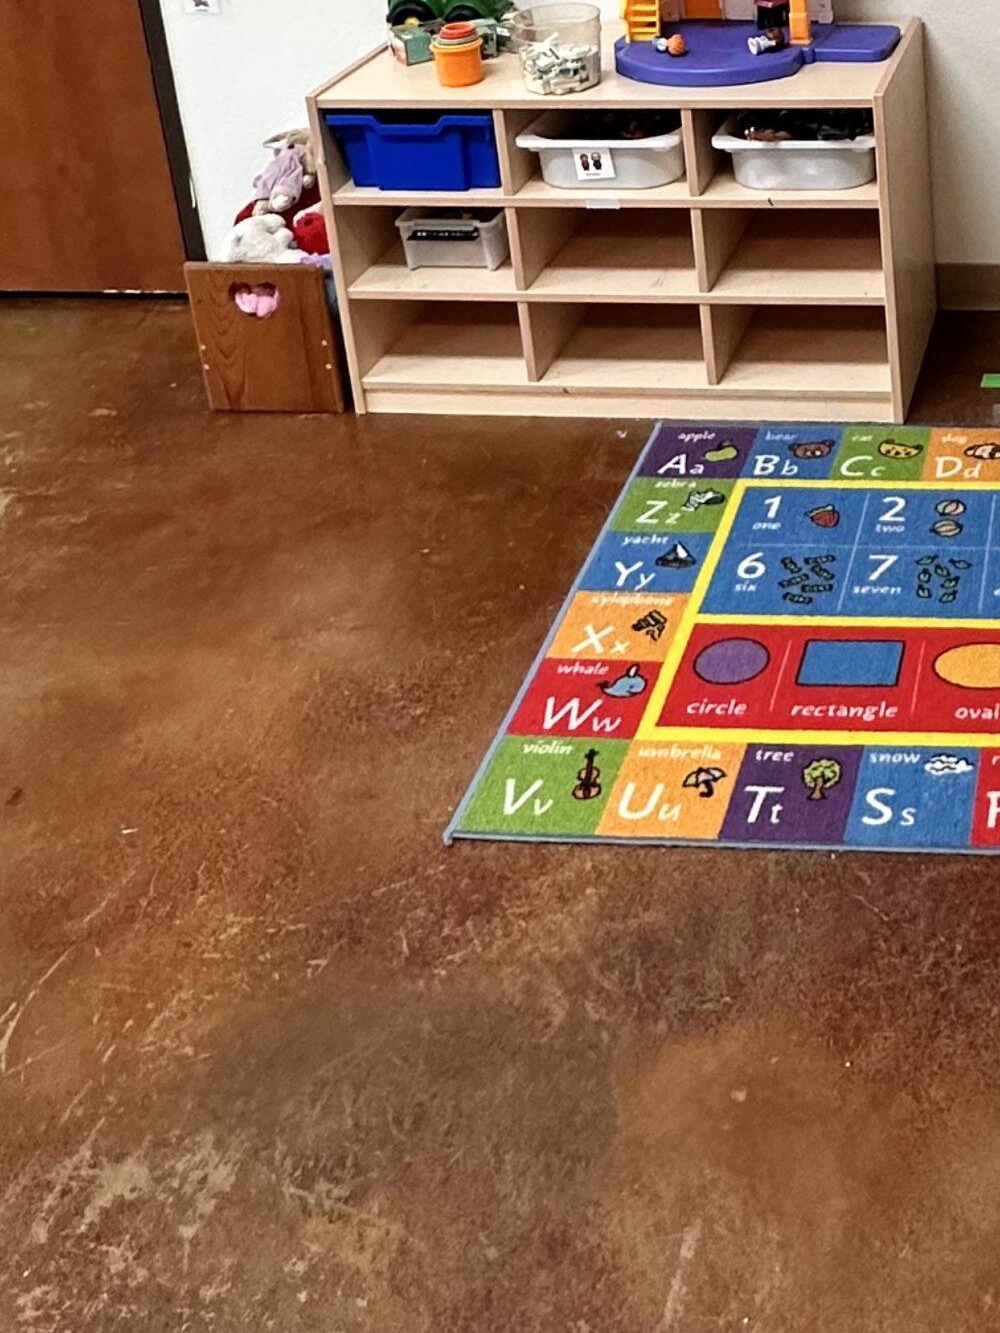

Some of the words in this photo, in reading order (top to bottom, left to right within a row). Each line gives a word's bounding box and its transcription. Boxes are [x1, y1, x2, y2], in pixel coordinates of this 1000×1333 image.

[678, 431, 716, 442] apple
[765, 431, 799, 441] bear
[941, 433, 967, 444] dog
[654, 479, 697, 489] zebra
[764, 495, 782, 519] 1
[879, 496, 905, 522] 2
[752, 521, 782, 530] one
[876, 524, 905, 533] two
[622, 535, 669, 546] yacht
[737, 552, 766, 579] 6
[868, 554, 899, 581] 7
[734, 583, 757, 592] six
[853, 585, 901, 594] seven
[557, 662, 610, 676] whale
[686, 698, 748, 715] circle
[790, 701, 899, 722] rectangle
[955, 703, 1000, 720] oval
[523, 741, 574, 755] violin
[638, 744, 721, 760] umbrella
[755, 749, 794, 763] tree
[869, 751, 922, 764] snow
